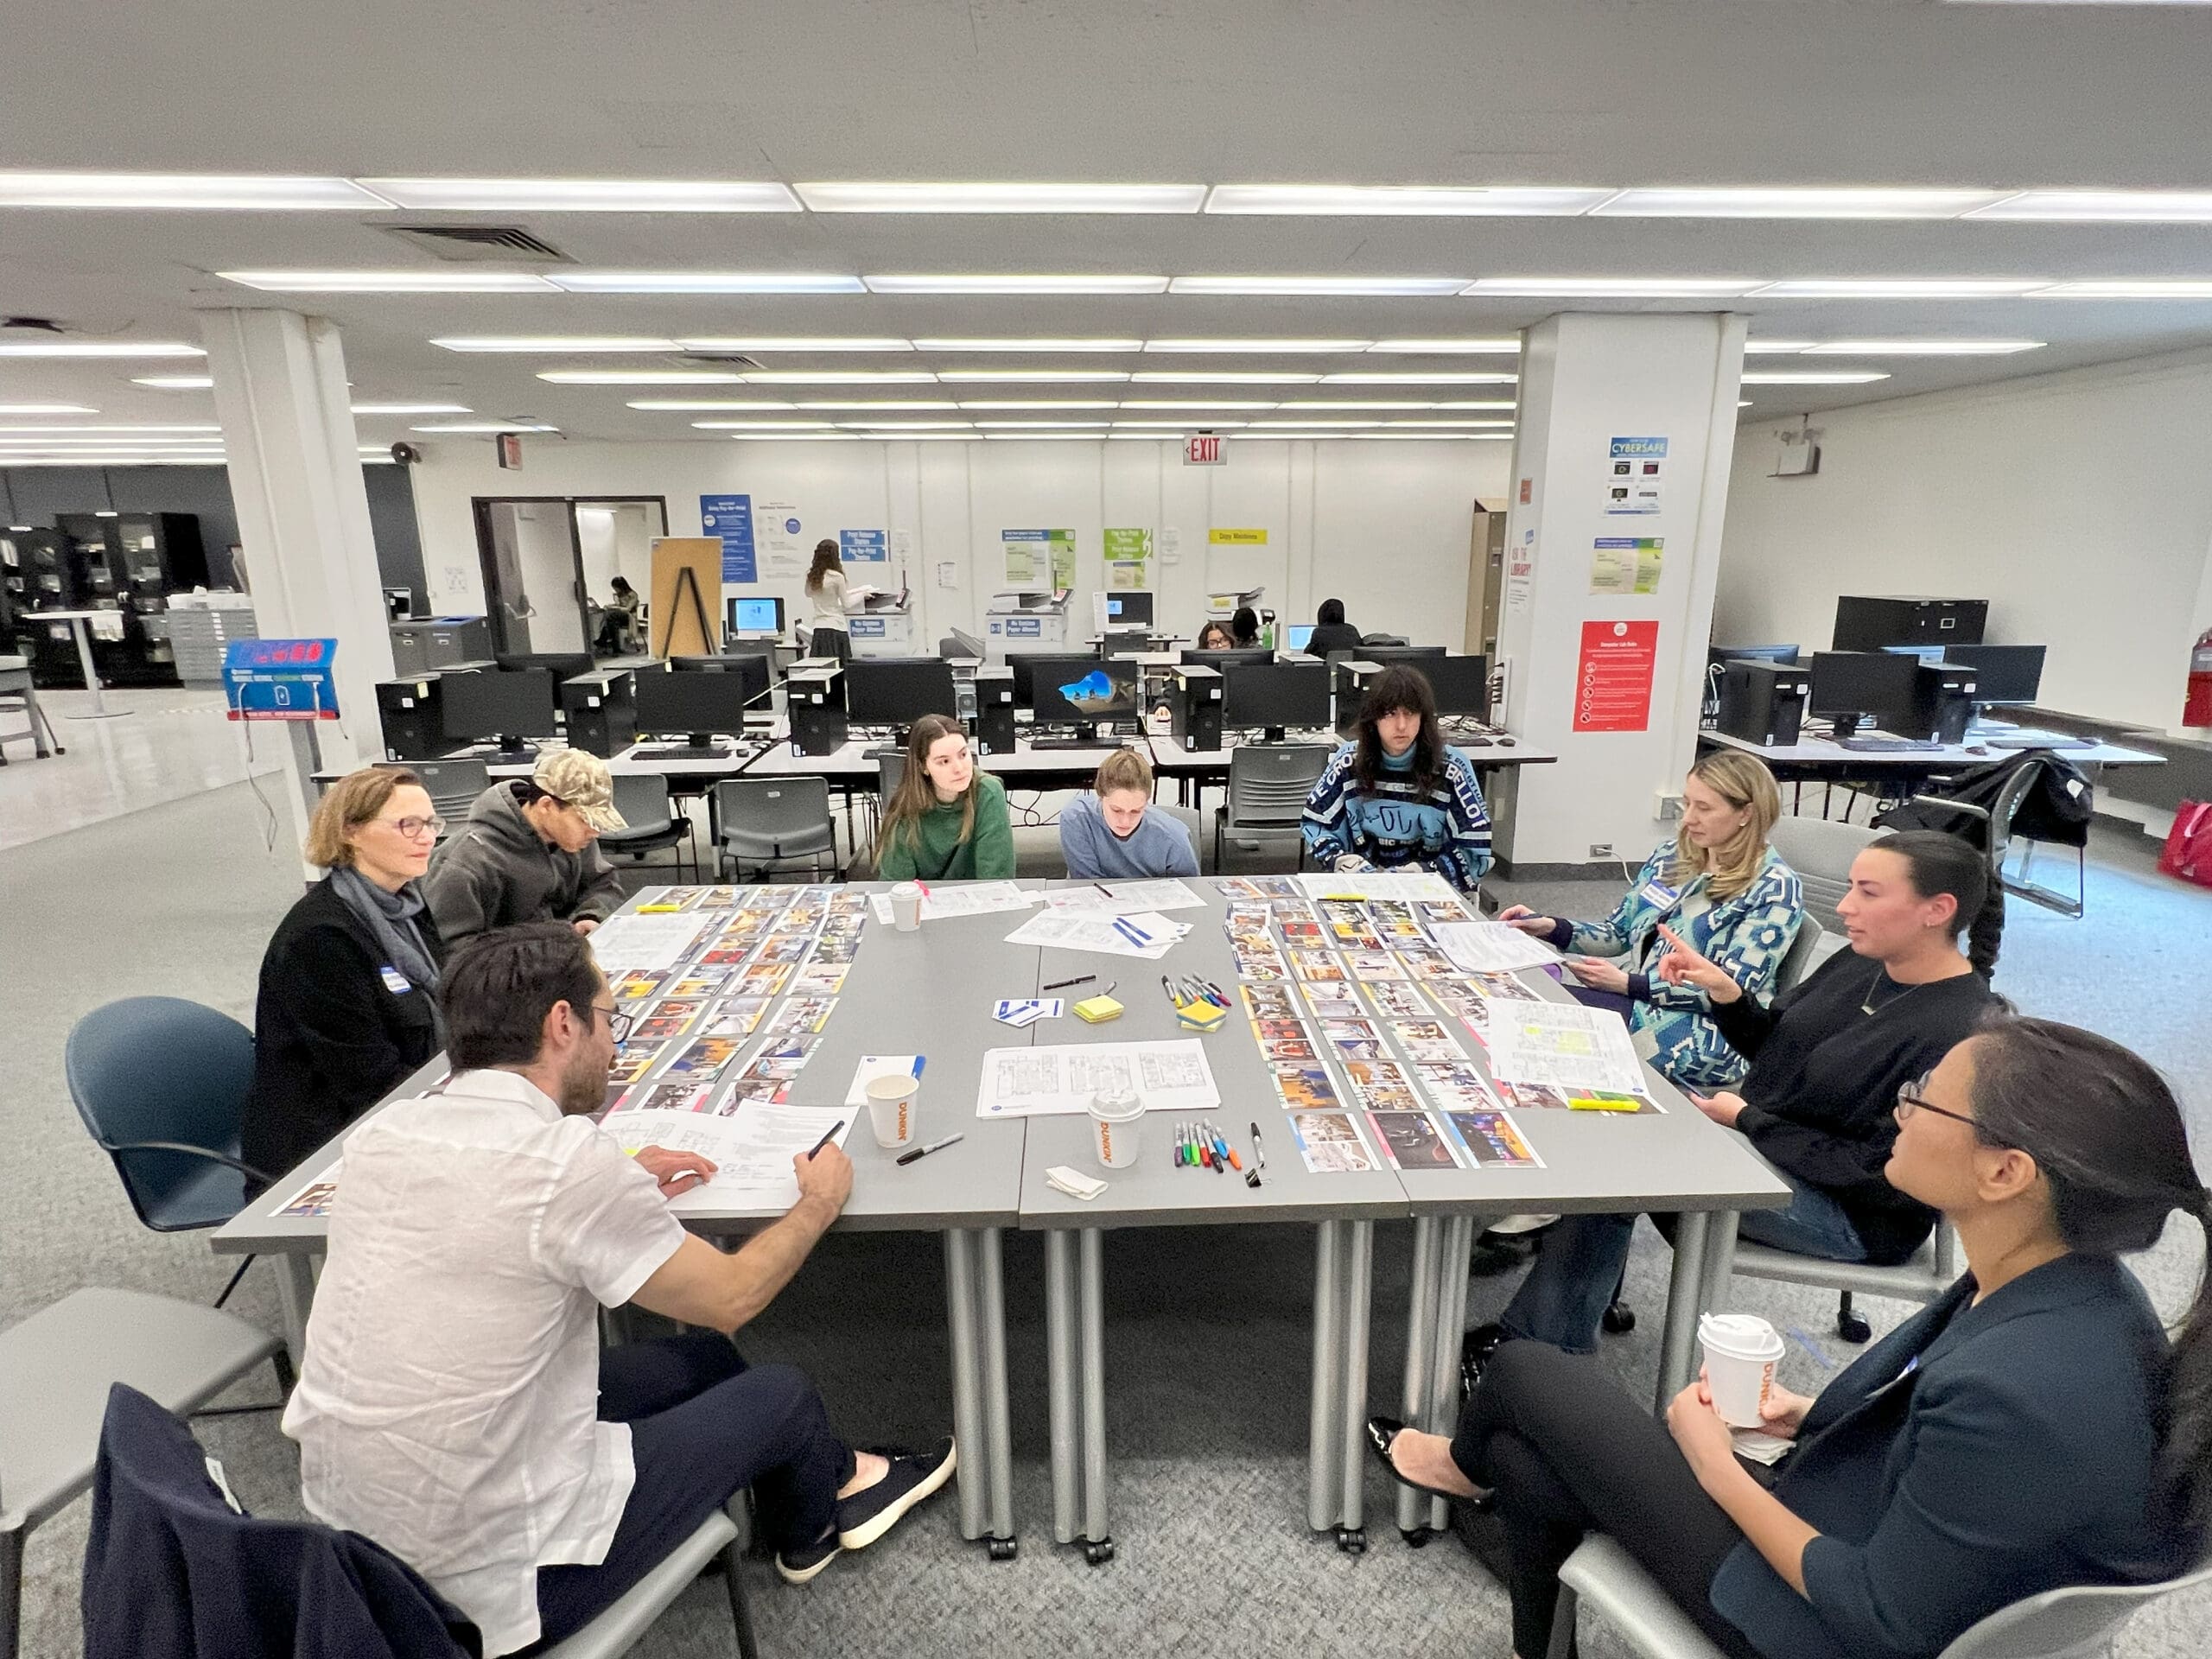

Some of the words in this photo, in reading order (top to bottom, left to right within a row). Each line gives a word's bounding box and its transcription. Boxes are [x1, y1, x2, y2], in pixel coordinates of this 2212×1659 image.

[1191, 437, 1220, 461] EXIT
[1611, 442, 1666, 454] CYBERSAFE
[1326, 753, 1357, 786] CRO
